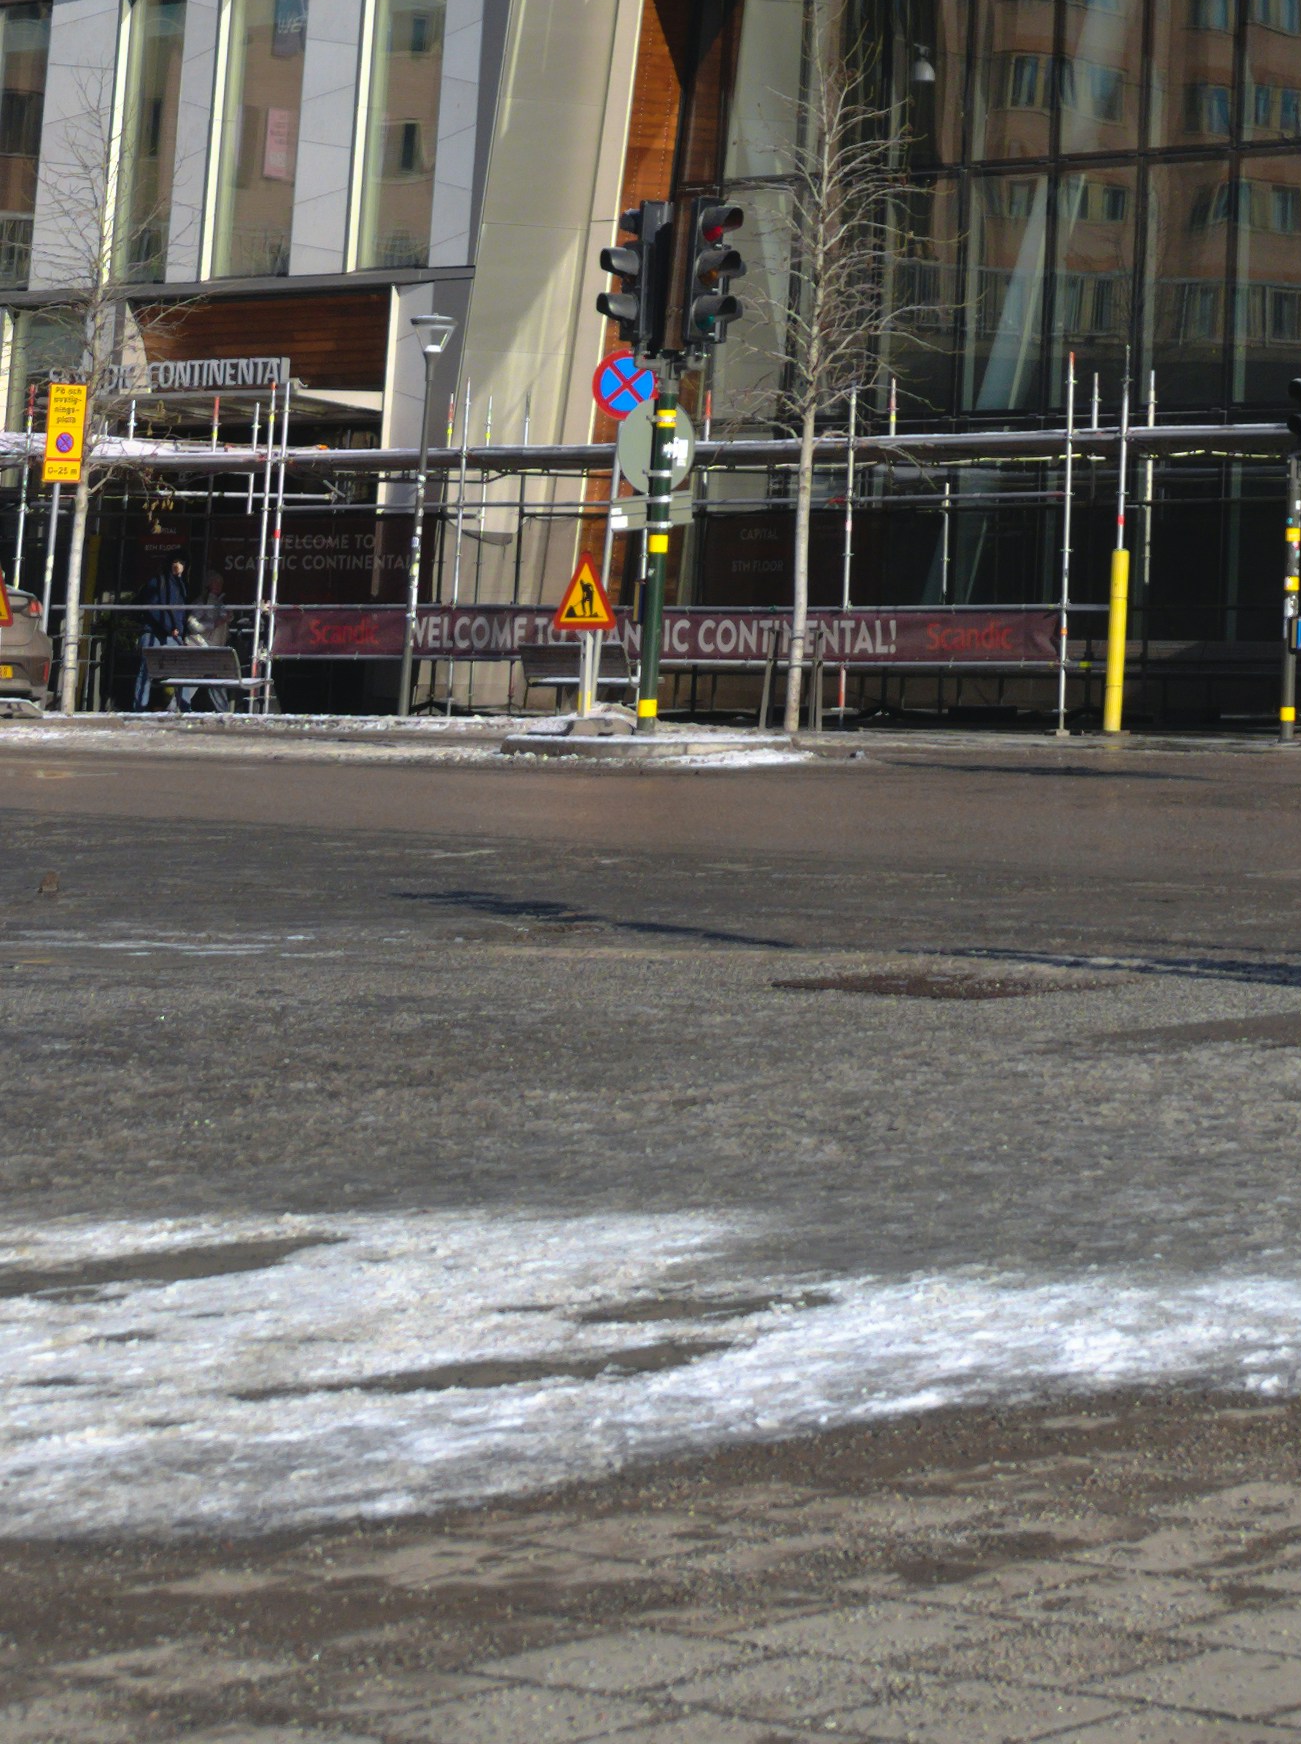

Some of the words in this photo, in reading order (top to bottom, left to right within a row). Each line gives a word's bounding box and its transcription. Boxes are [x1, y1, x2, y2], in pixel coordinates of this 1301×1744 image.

[147, 356, 291, 391] CONTINENTAL
[309, 612, 380, 646] Scandic
[925, 618, 1013, 652] Scandic
